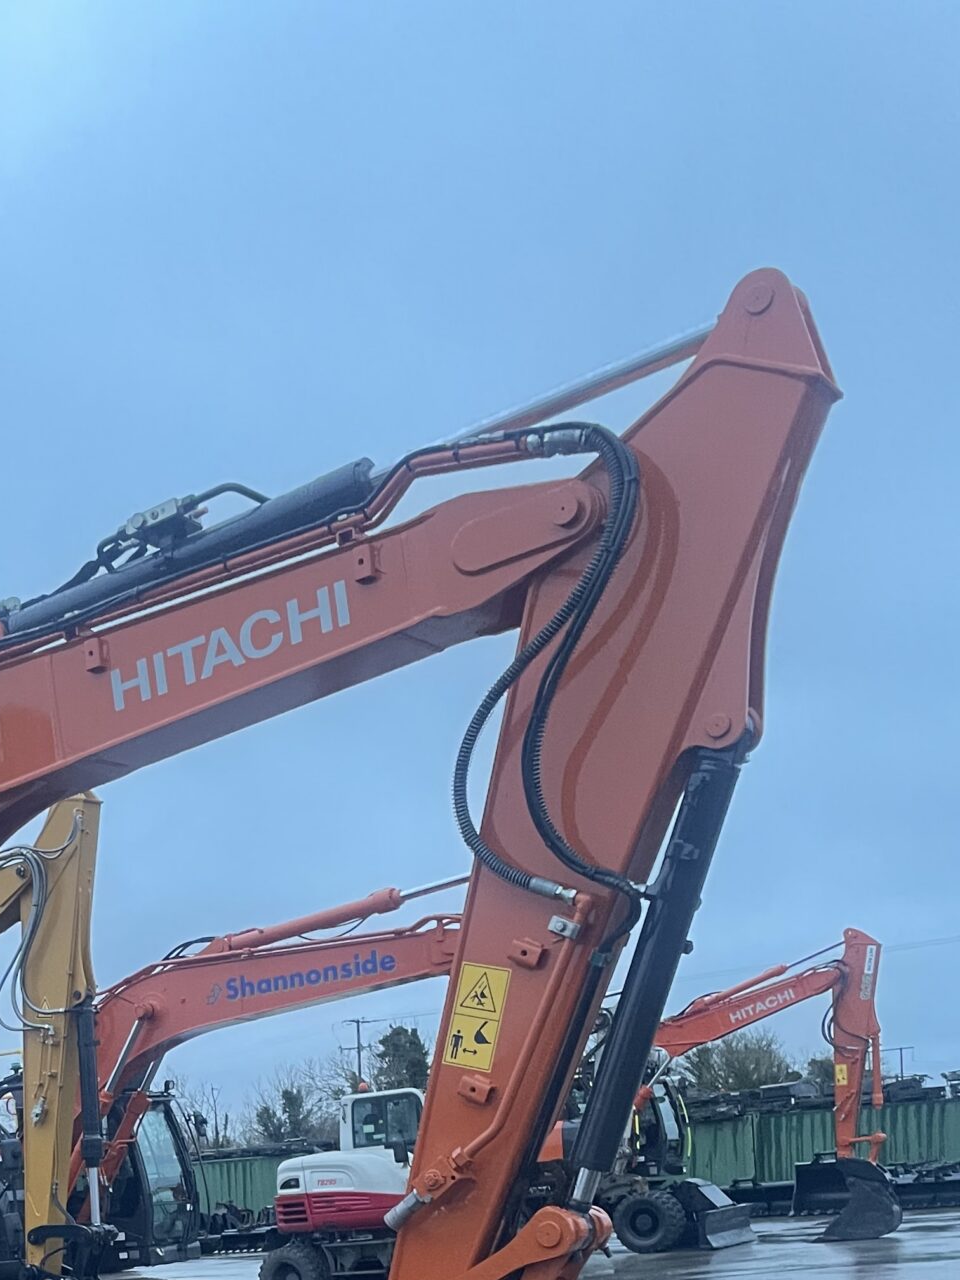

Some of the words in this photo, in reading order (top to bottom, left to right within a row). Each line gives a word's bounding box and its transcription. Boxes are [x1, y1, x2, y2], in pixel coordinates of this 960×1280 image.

[110, 580, 350, 711] HITACHI
[225, 950, 396, 1000] Shannonside
[728, 988, 796, 1024] HITACHI
